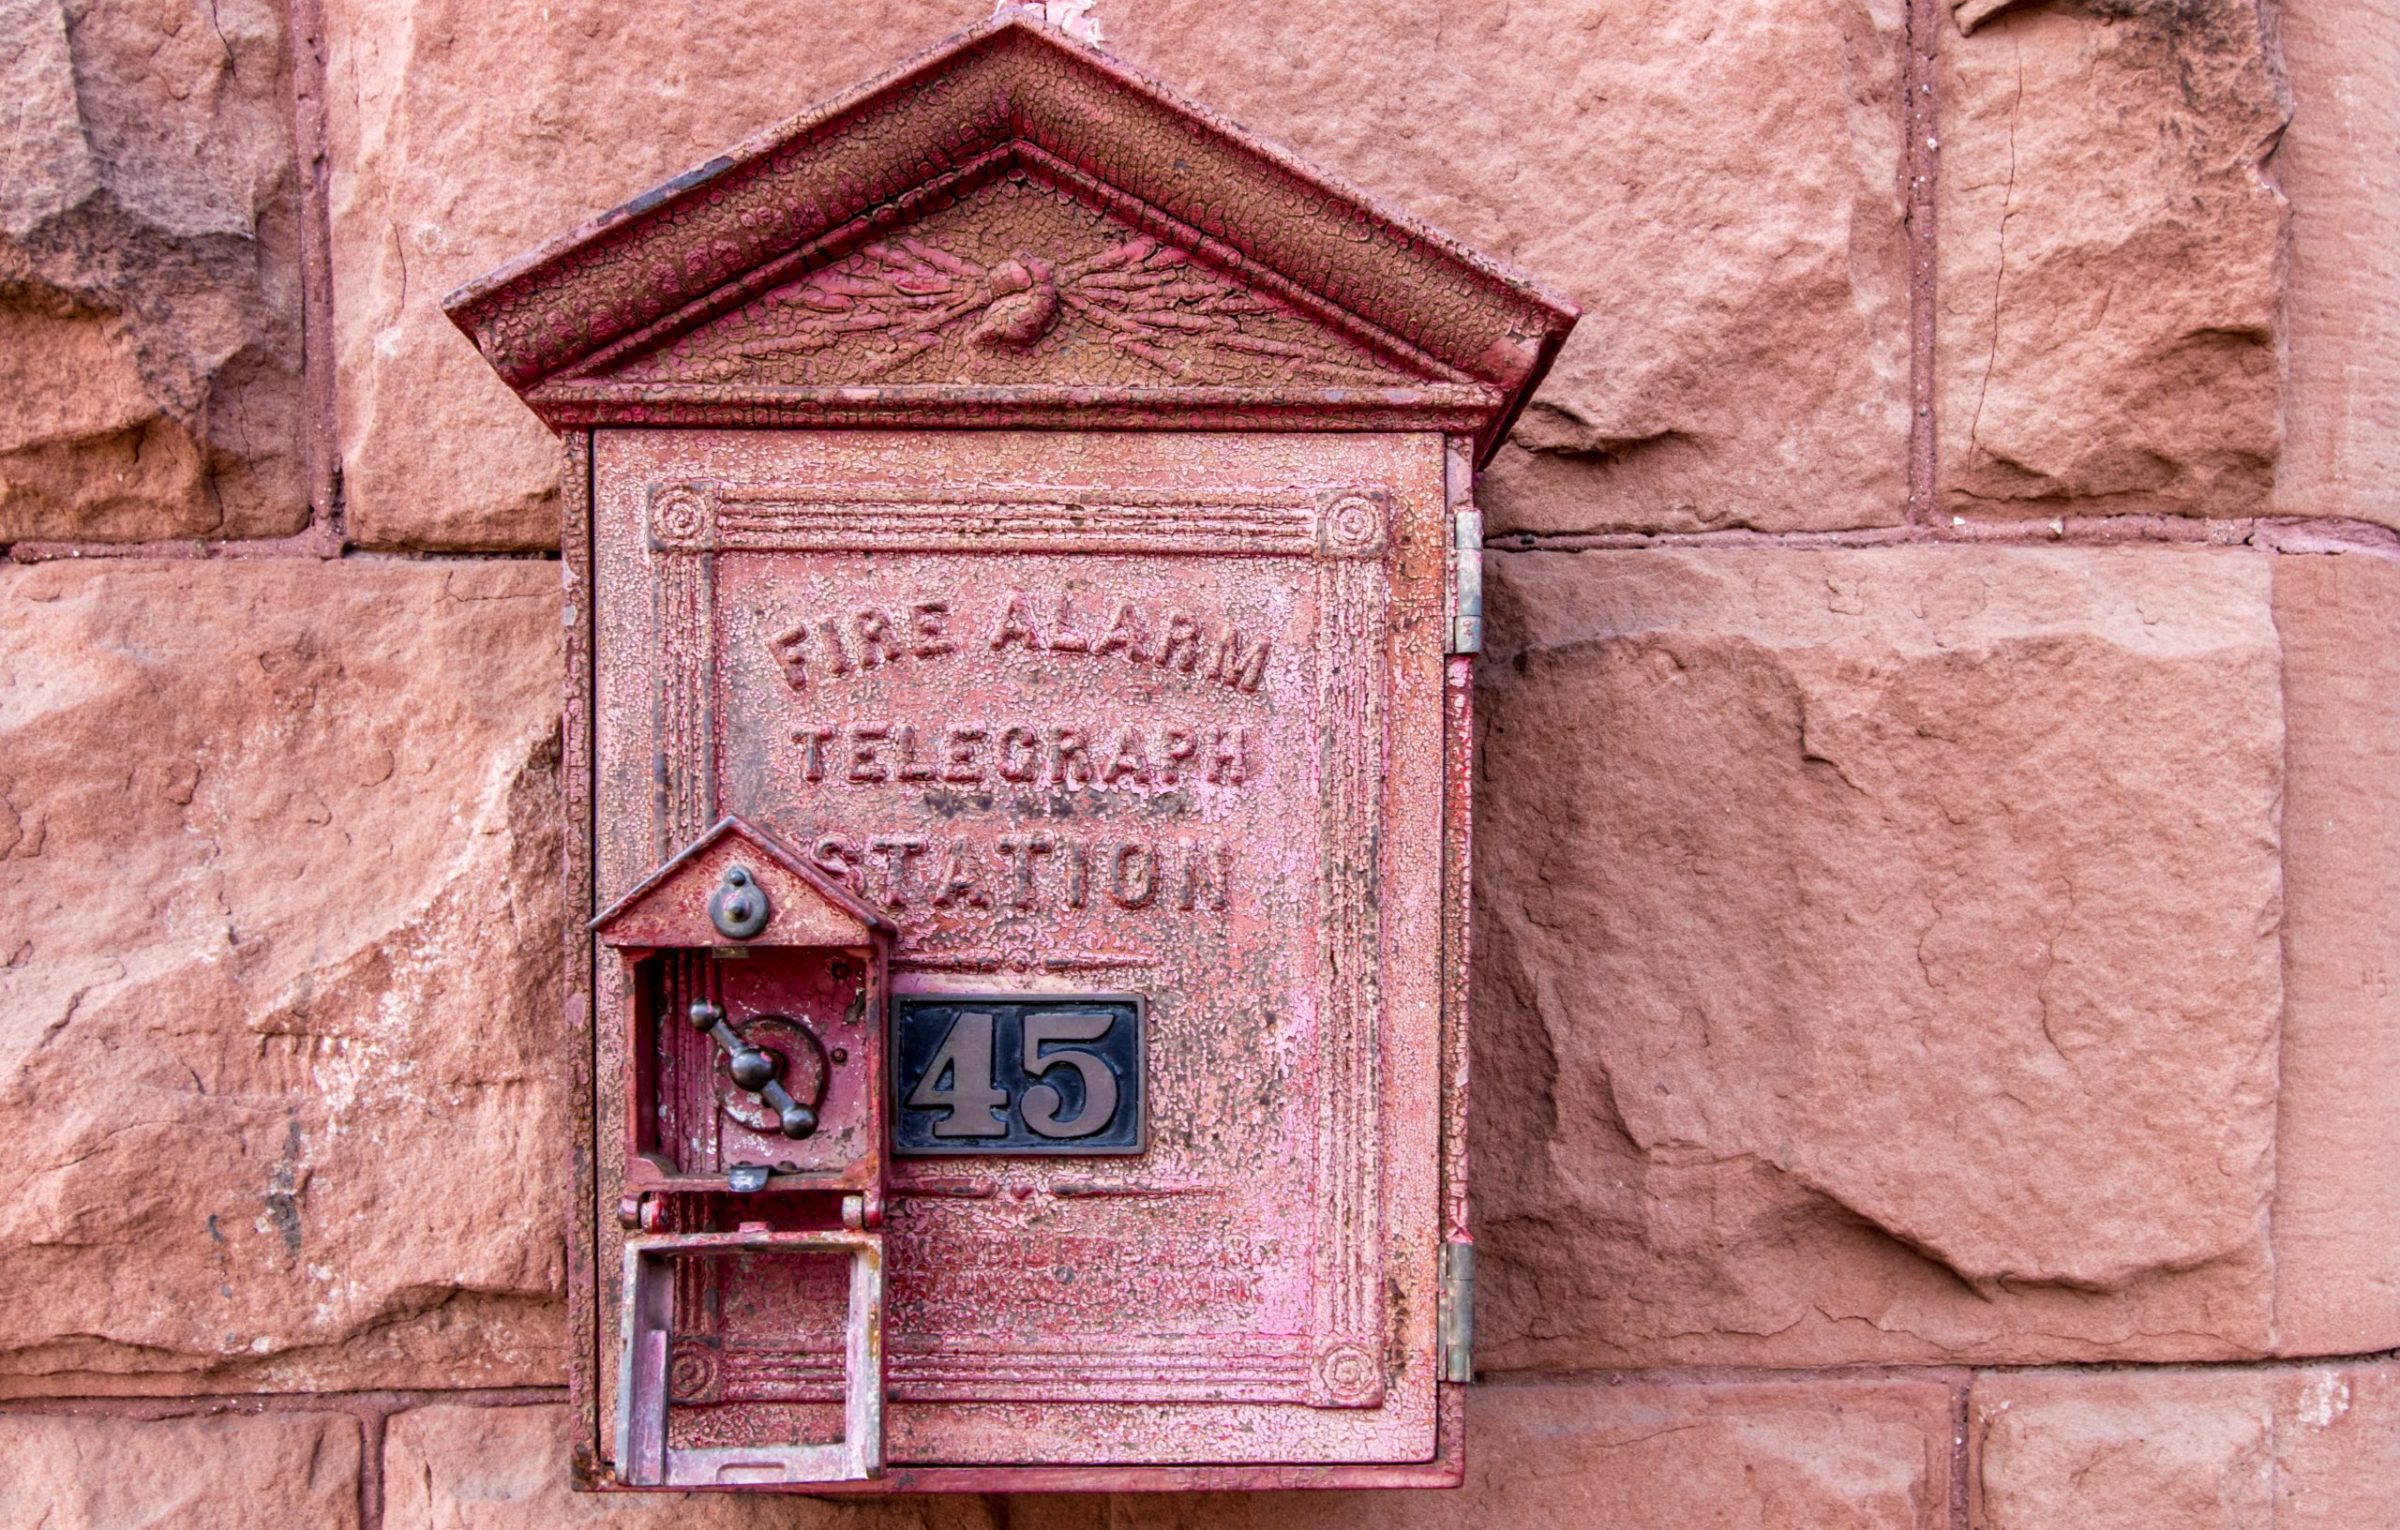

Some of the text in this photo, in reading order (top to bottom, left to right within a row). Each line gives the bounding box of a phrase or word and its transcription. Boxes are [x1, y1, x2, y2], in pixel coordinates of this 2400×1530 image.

[767, 588, 1272, 693] FIRE ALARM
[790, 720, 1249, 785] TELEGRAPH
[809, 833, 1232, 912] STATION
[907, 1009, 1119, 1139] 45
